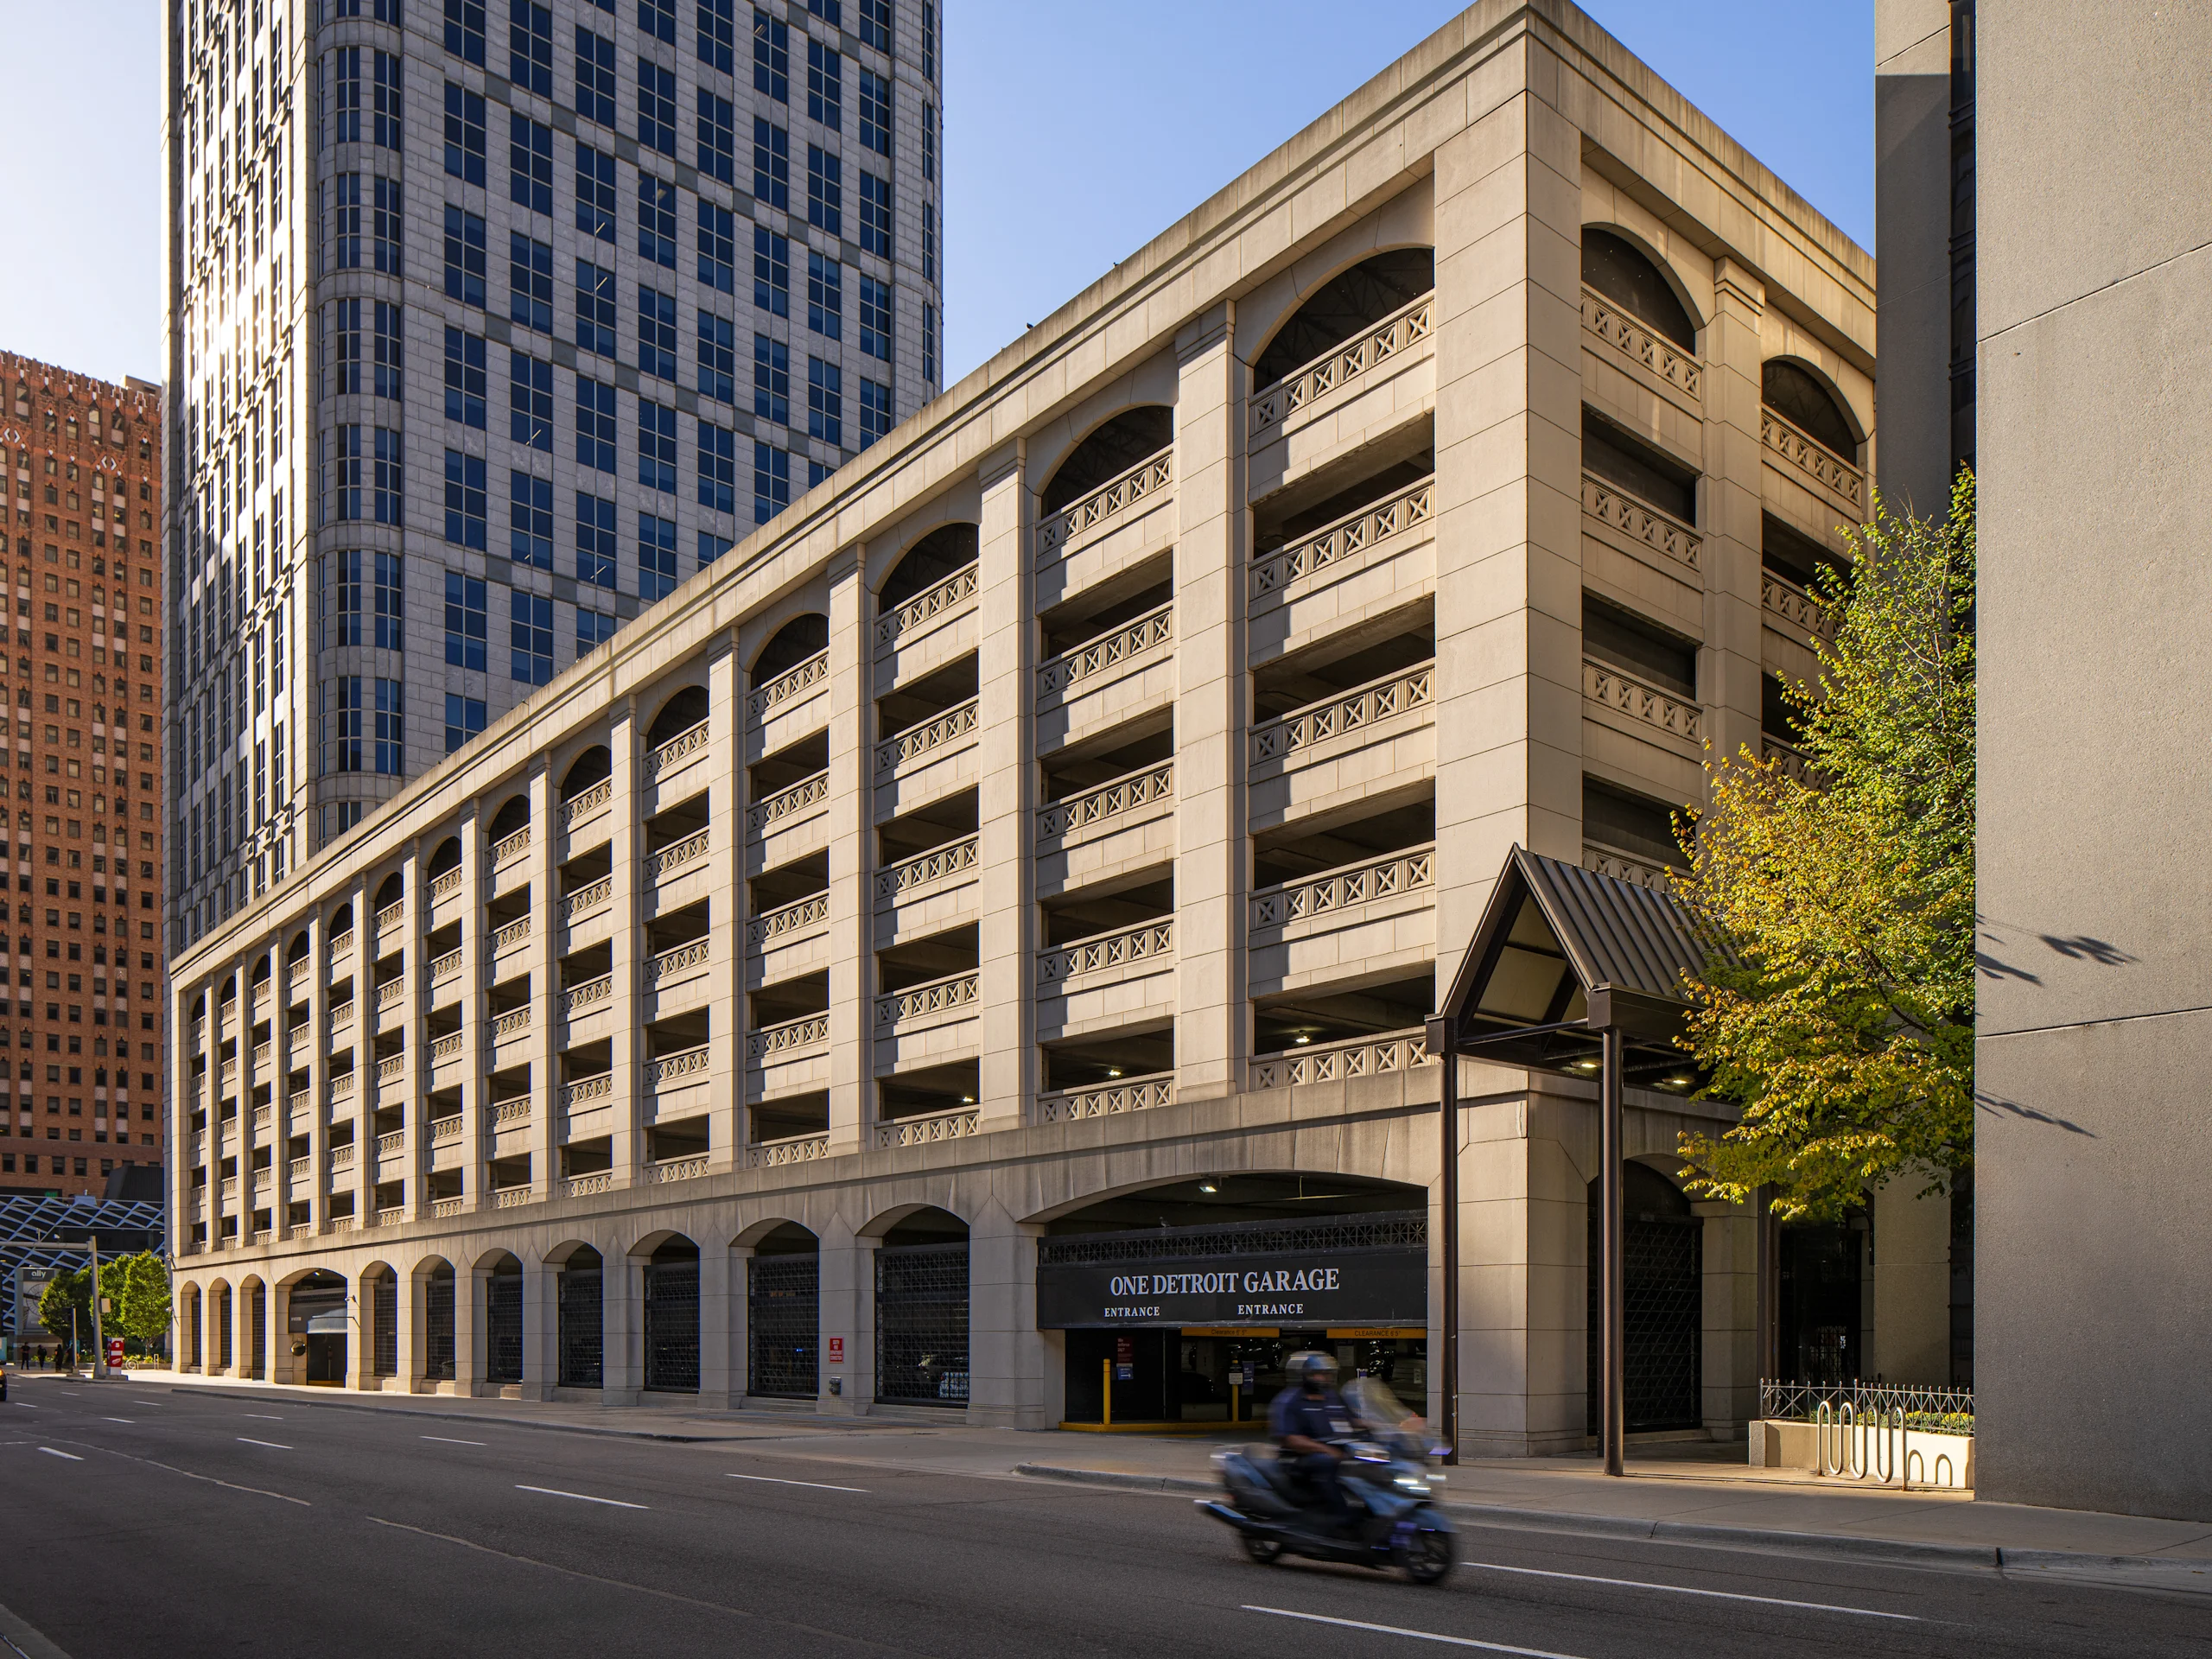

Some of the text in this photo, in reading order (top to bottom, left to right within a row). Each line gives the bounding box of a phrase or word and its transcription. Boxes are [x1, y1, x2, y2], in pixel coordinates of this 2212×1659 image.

[31, 1269, 46, 1278] ally
[1110, 1268, 1339, 1295] ONE DETROIT GARAGE
[1104, 1306, 1160, 1318] ENTRANCE
[1237, 1303, 1303, 1315] ENTRANCE
